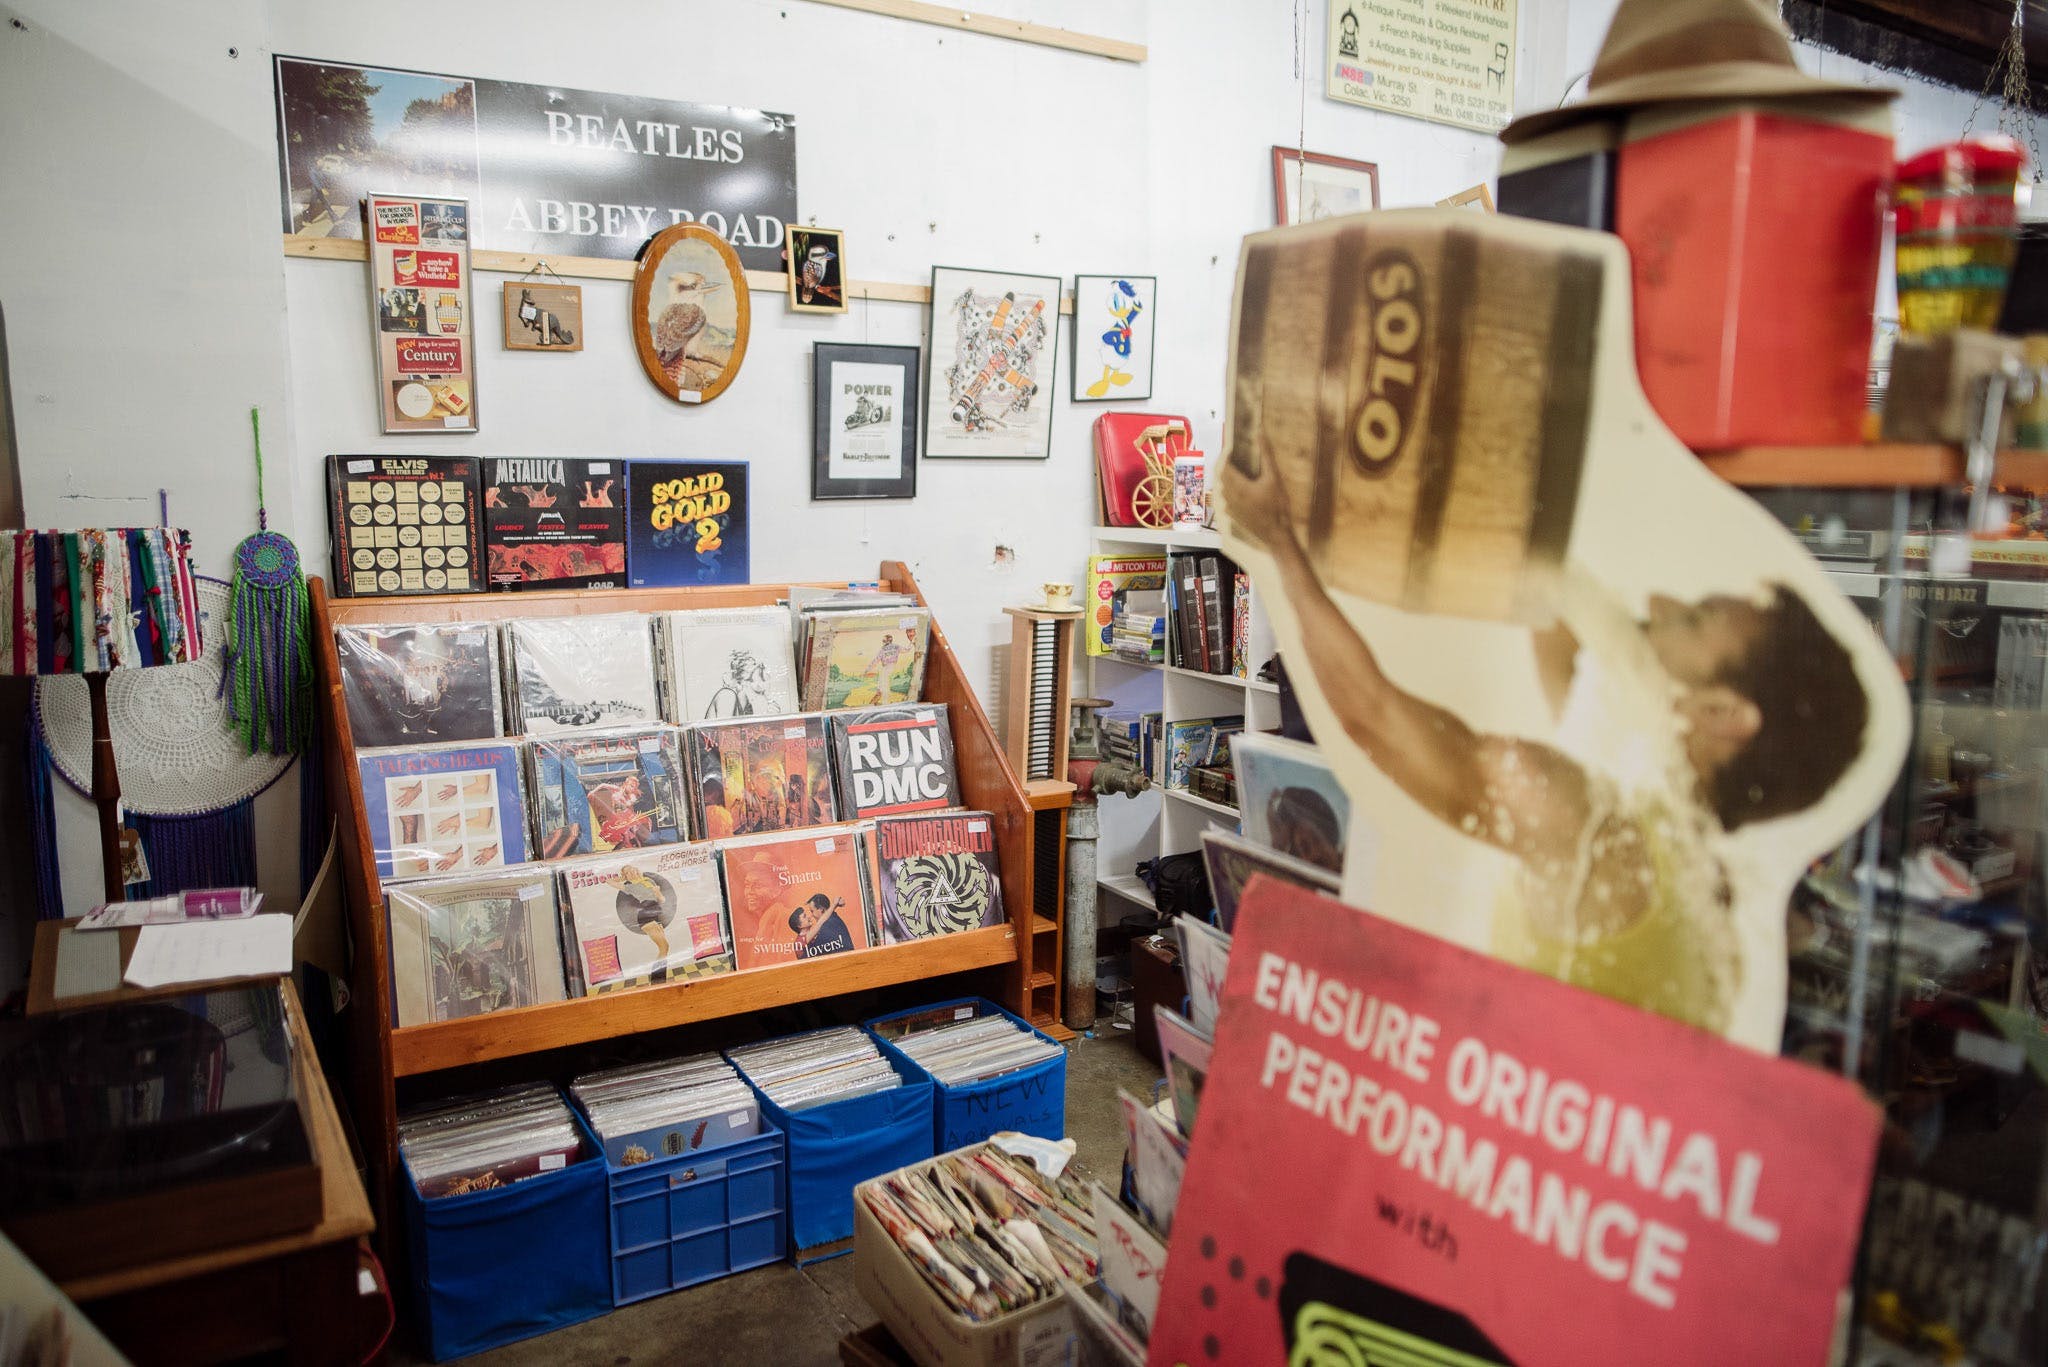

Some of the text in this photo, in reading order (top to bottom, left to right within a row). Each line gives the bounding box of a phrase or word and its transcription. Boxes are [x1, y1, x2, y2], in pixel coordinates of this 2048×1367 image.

[544, 111, 744, 164] BEATLES
[505, 197, 660, 240] ABBEY
[417, 271, 447, 281] Winfield
[397, 339, 417, 351] NEW
[403, 348, 457, 367] Century
[1355, 261, 1424, 463] SOLO
[844, 384, 892, 396] POWER
[381, 459, 429, 470] ELVIS
[439, 472, 445, 480] 2
[496, 459, 566, 487] METALLICA
[652, 472, 724, 505] SOLID
[651, 490, 731, 531] GOLD
[695, 517, 723, 554] 2
[1113, 562, 1146, 572] METCON
[588, 581, 615, 590] LOAD
[605, 734, 674, 753] LAUR
[850, 726, 943, 771] RUN
[375, 750, 503, 775] TALKING HEADS
[852, 763, 949, 808] DMC
[881, 817, 993, 860] SOUNDGARDEN
[656, 855, 709, 873] DEAD HORSE
[660, 848, 700, 863] FLOGGING
[778, 870, 822, 886] Sinatra
[806, 935, 845, 958] lovers!
[967, 1072, 1049, 1117] NEW
[1253, 951, 1782, 1247] ENSURE ORIGINAL
[1260, 1031, 1688, 1309] PERFORMANCE
[1376, 1193, 1460, 1264] with
